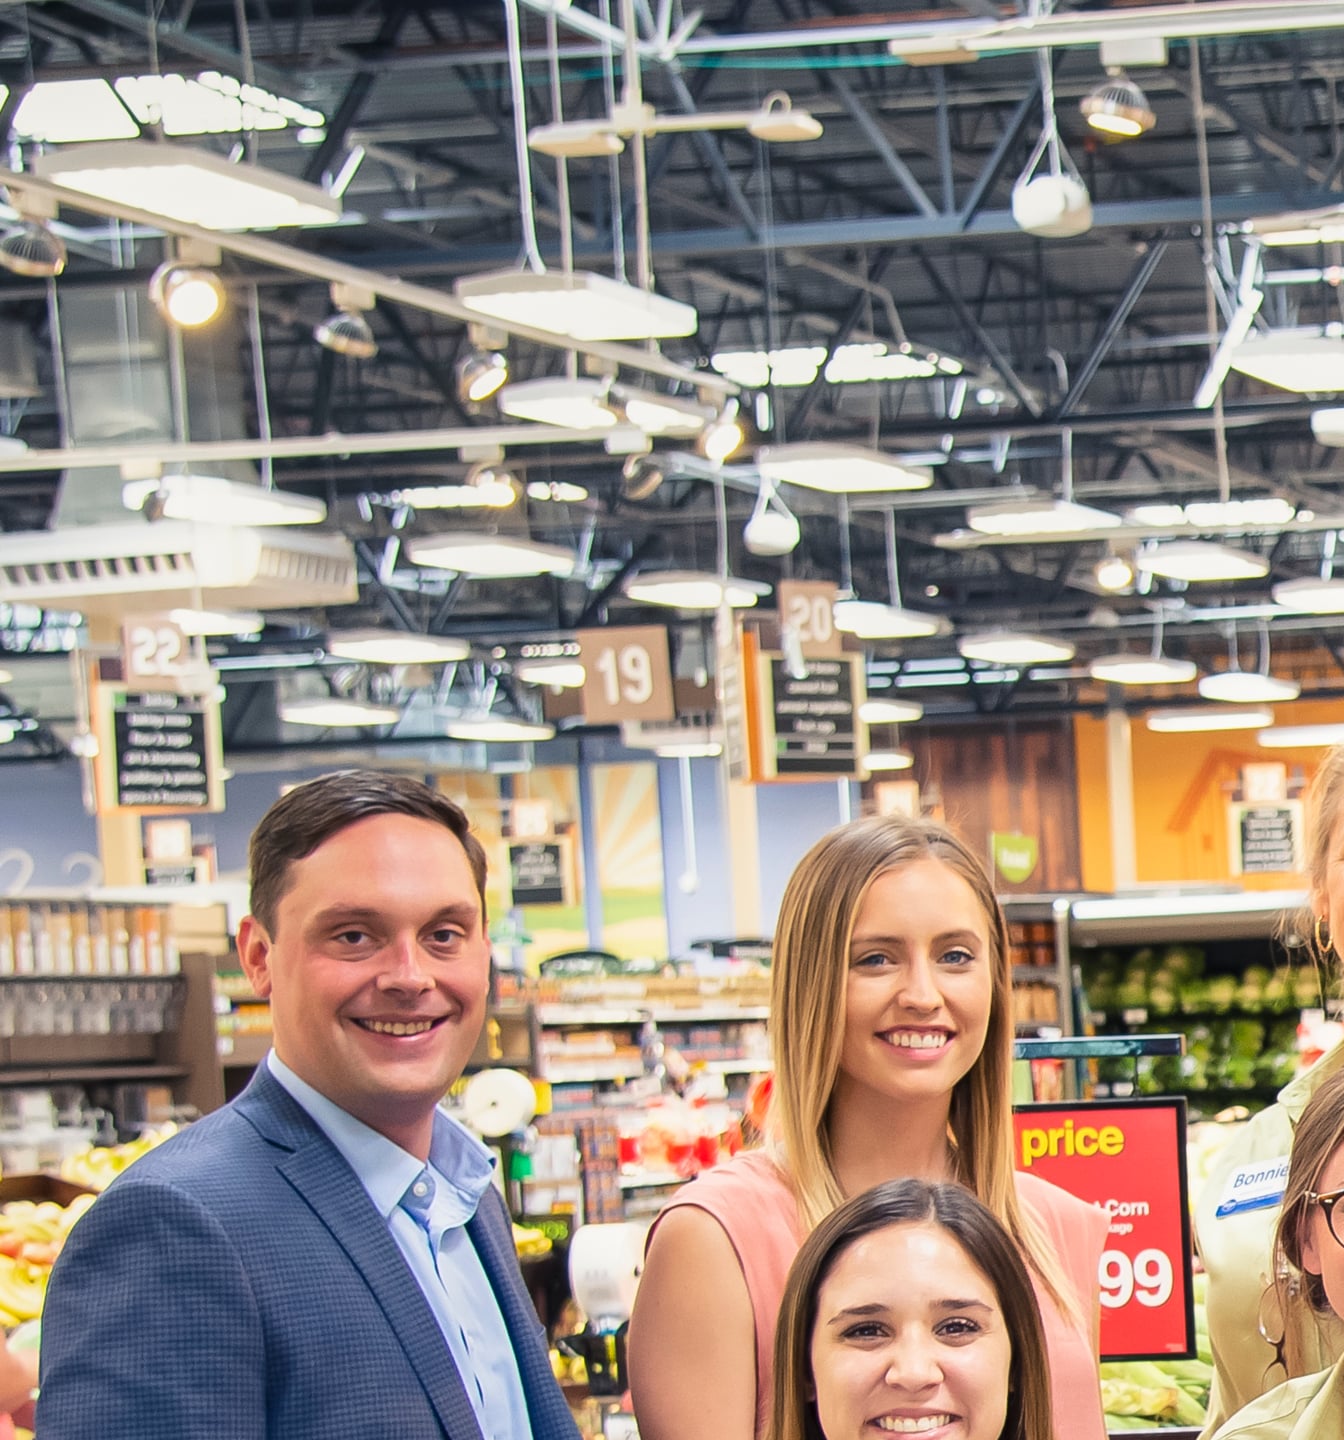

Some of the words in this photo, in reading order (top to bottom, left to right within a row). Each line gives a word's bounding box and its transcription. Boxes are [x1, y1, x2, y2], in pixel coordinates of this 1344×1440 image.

[785, 596, 833, 642] 20
[131, 626, 183, 676] 22
[595, 644, 653, 705] 19
[1022, 1119, 1125, 1167] price
[1233, 1164, 1288, 1188] Bonnie
[1106, 1199, 1149, 1216] Corn
[1098, 1248, 1173, 1308] 99
